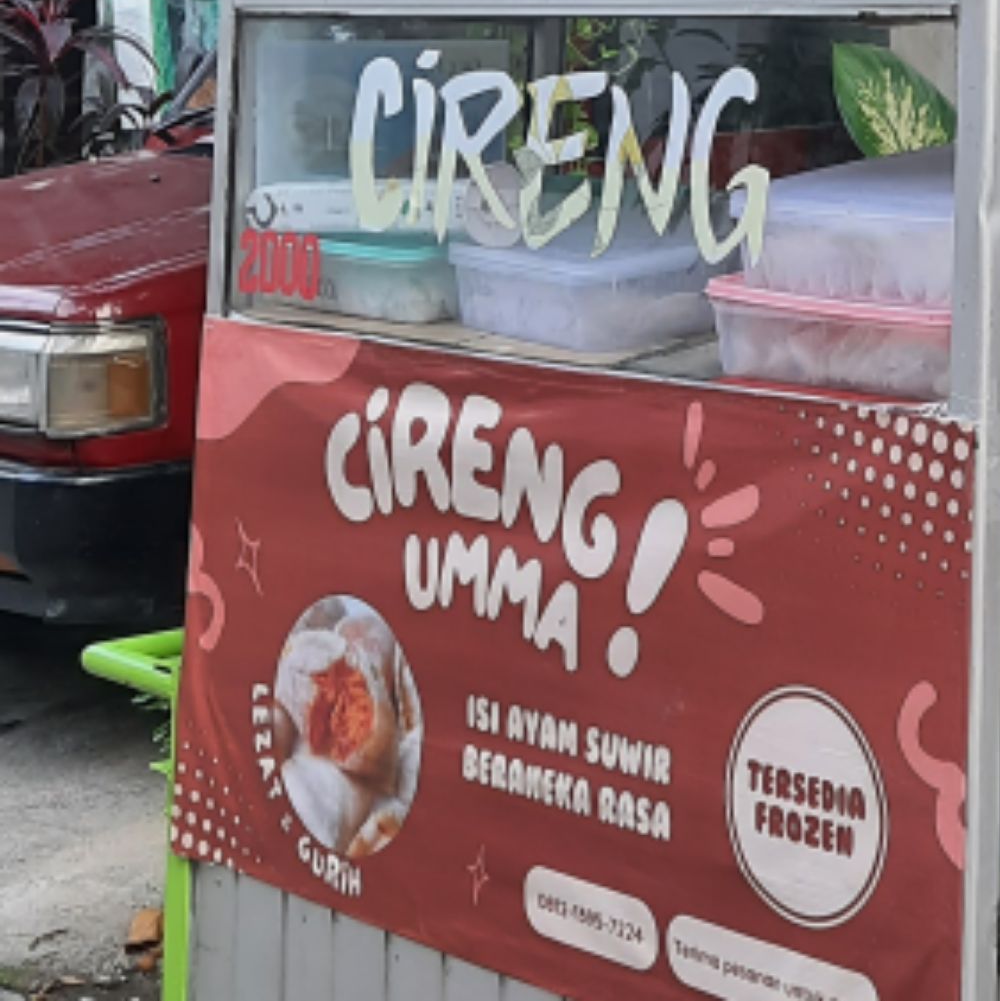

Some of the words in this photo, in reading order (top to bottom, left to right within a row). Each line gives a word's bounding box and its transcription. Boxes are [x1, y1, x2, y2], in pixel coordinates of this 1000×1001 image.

[238, 227, 321, 300] 2000
[405, 532, 578, 672] UMMA
[252, 683, 282, 799] LEZAT
[466, 694, 499, 735] ISI
[507, 705, 578, 757] AYAM
[585, 726, 671, 785] SUWIR
[462, 744, 592, 816] BERANEKA
[598, 786, 671, 841] RASA
[747, 759, 866, 821] TERSEDIA
[754, 801, 854, 859] FROZEN
